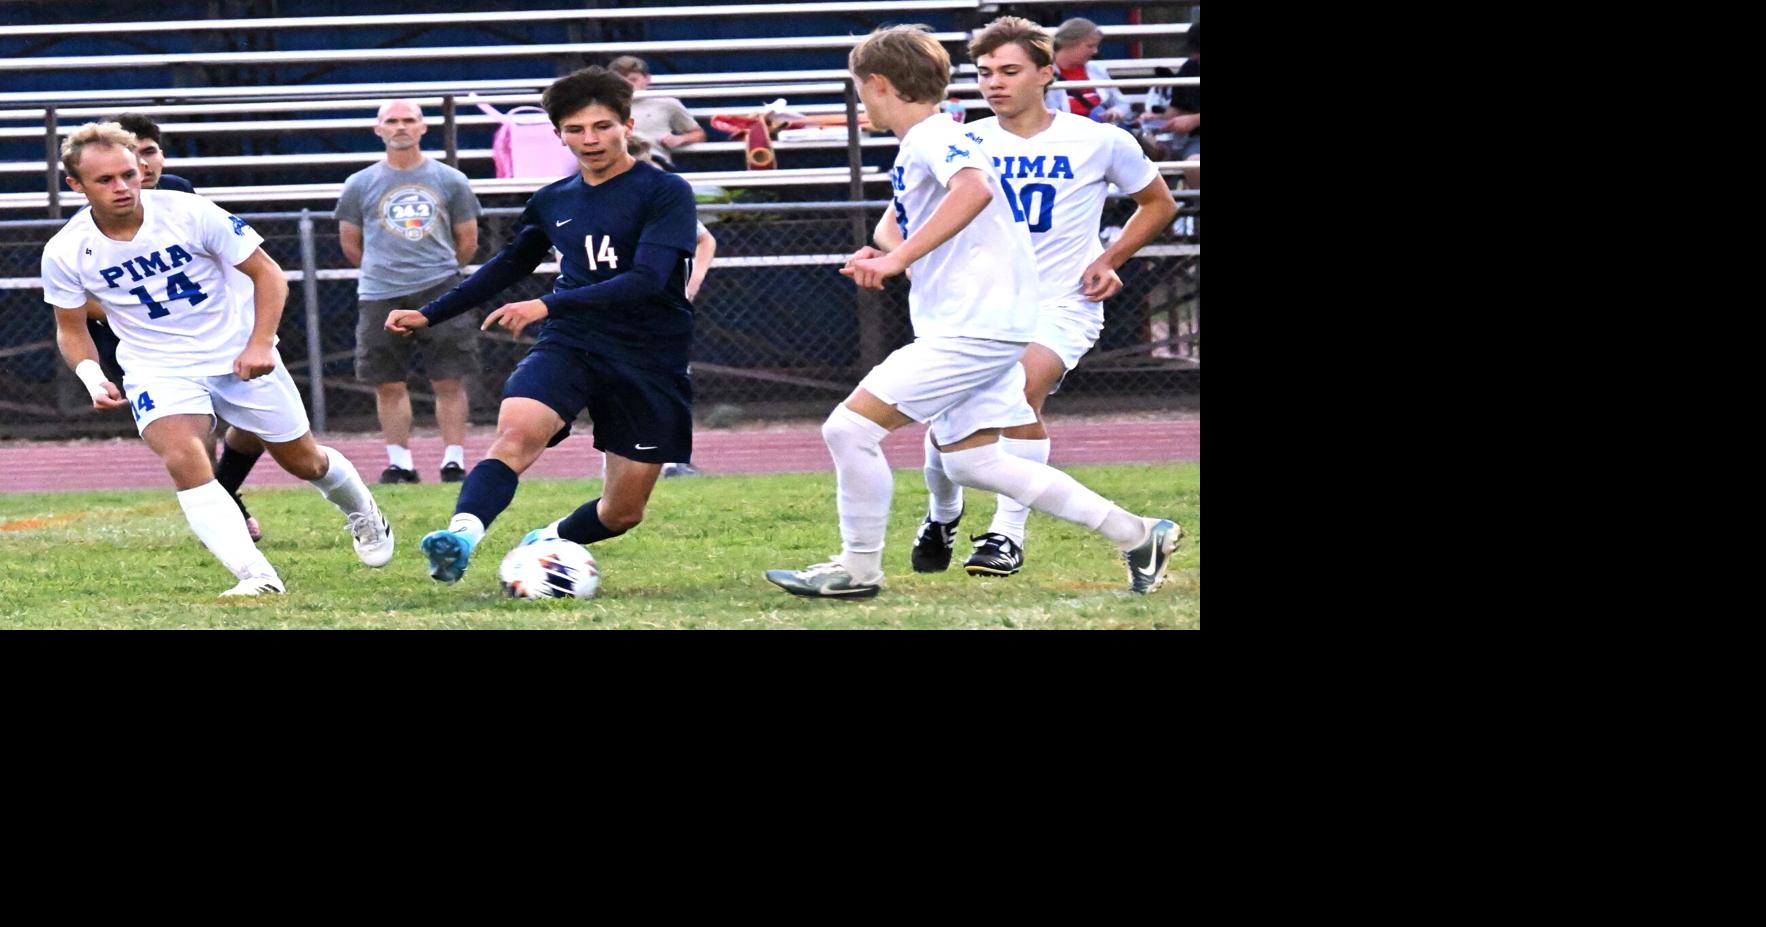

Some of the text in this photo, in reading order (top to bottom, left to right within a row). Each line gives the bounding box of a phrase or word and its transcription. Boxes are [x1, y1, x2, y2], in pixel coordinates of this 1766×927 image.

[100, 244, 192, 288] PIMA
[585, 234, 618, 270] 14
[129, 271, 208, 320] 14
